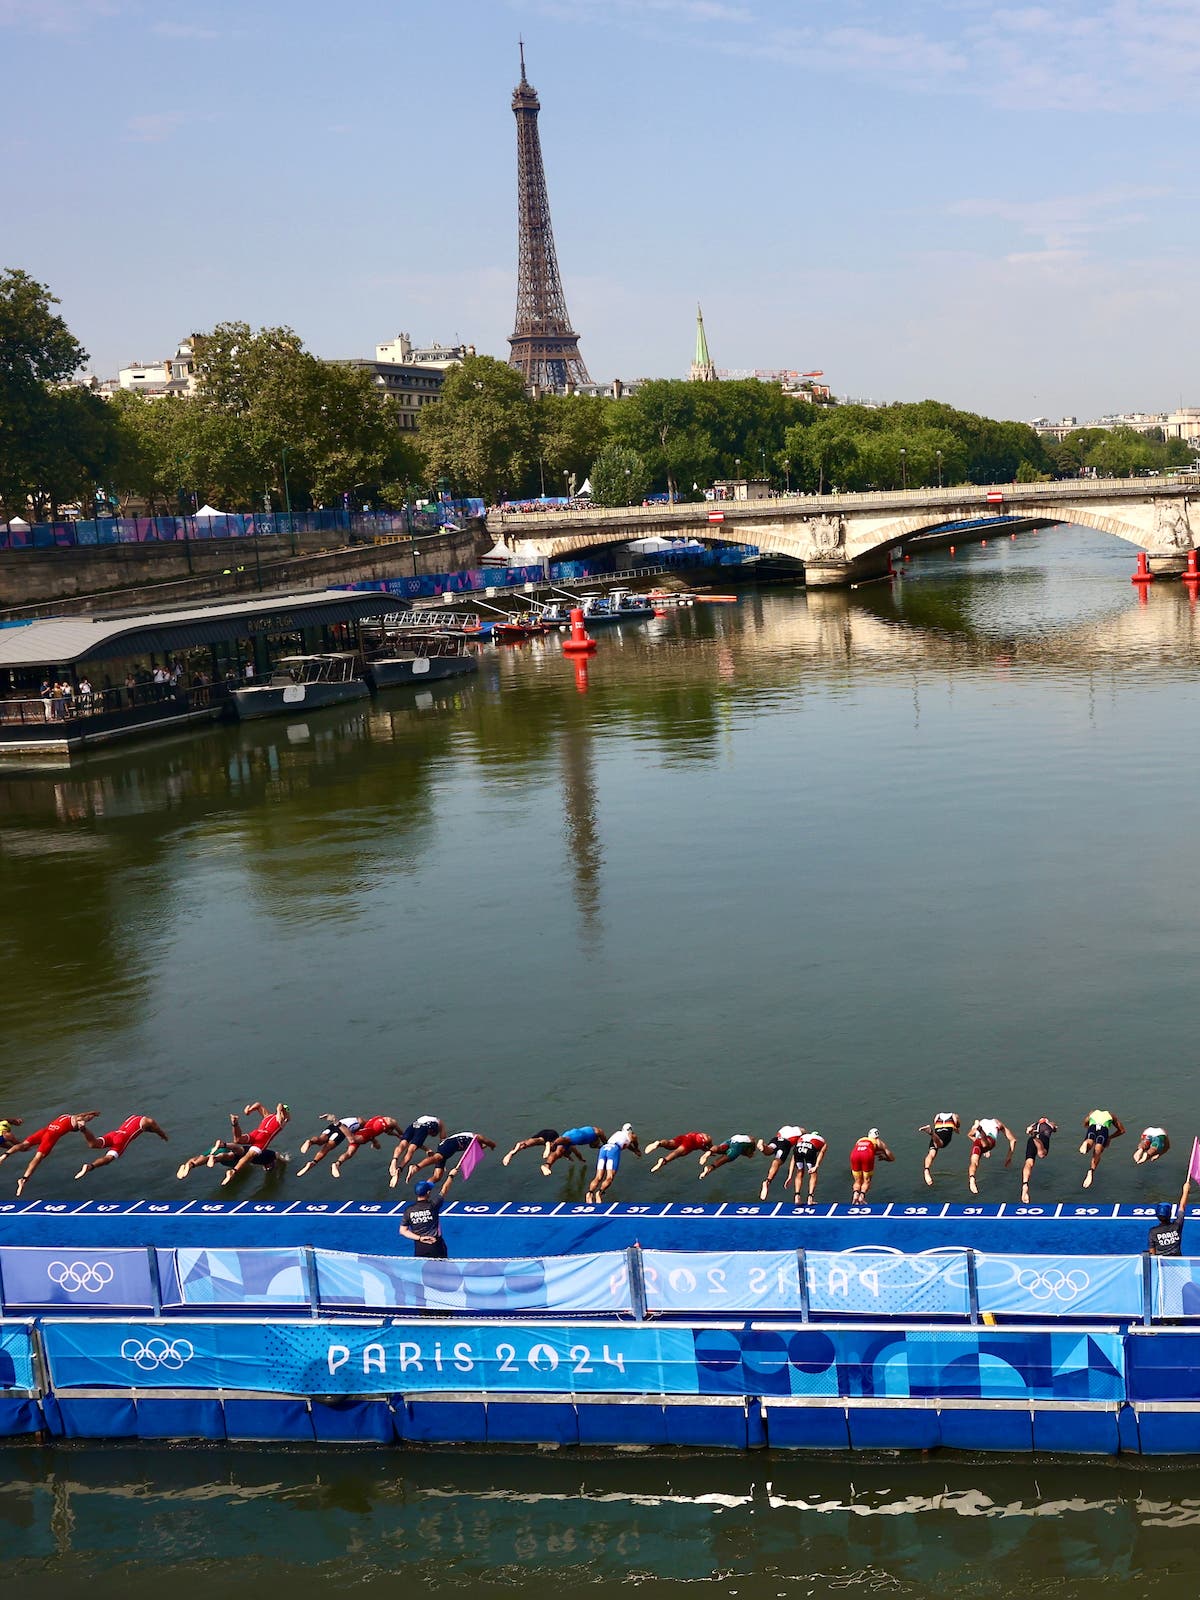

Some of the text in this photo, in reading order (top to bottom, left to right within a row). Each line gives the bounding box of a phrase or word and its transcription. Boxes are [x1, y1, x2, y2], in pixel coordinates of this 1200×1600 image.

[96, 1204, 120, 1212] 47
[148, 1204, 170, 1212] 46
[201, 1204, 225, 1212] 45
[253, 1204, 276, 1212] 44
[305, 1204, 329, 1212] 43
[359, 1204, 382, 1212] 42
[463, 1205, 490, 1213] 40
[517, 1205, 543, 1214] 39
[571, 1205, 596, 1214] 38
[626, 1206, 651, 1214] 37
[680, 1206, 705, 1214] 36
[735, 1206, 761, 1215] 35
[791, 1207, 816, 1215] 34
[847, 1207, 872, 1215] 33
[903, 1207, 929, 1215] 32
[962, 1207, 983, 1215] 31
[1015, 1207, 1044, 1215] 30
[1074, 1207, 1100, 1216] 29
[1132, 1208, 1157, 1216] 28
[409, 1209, 432, 1219] PARIS
[1156, 1230, 1179, 1241] PARIS
[495, 1343, 625, 1374] 2024
